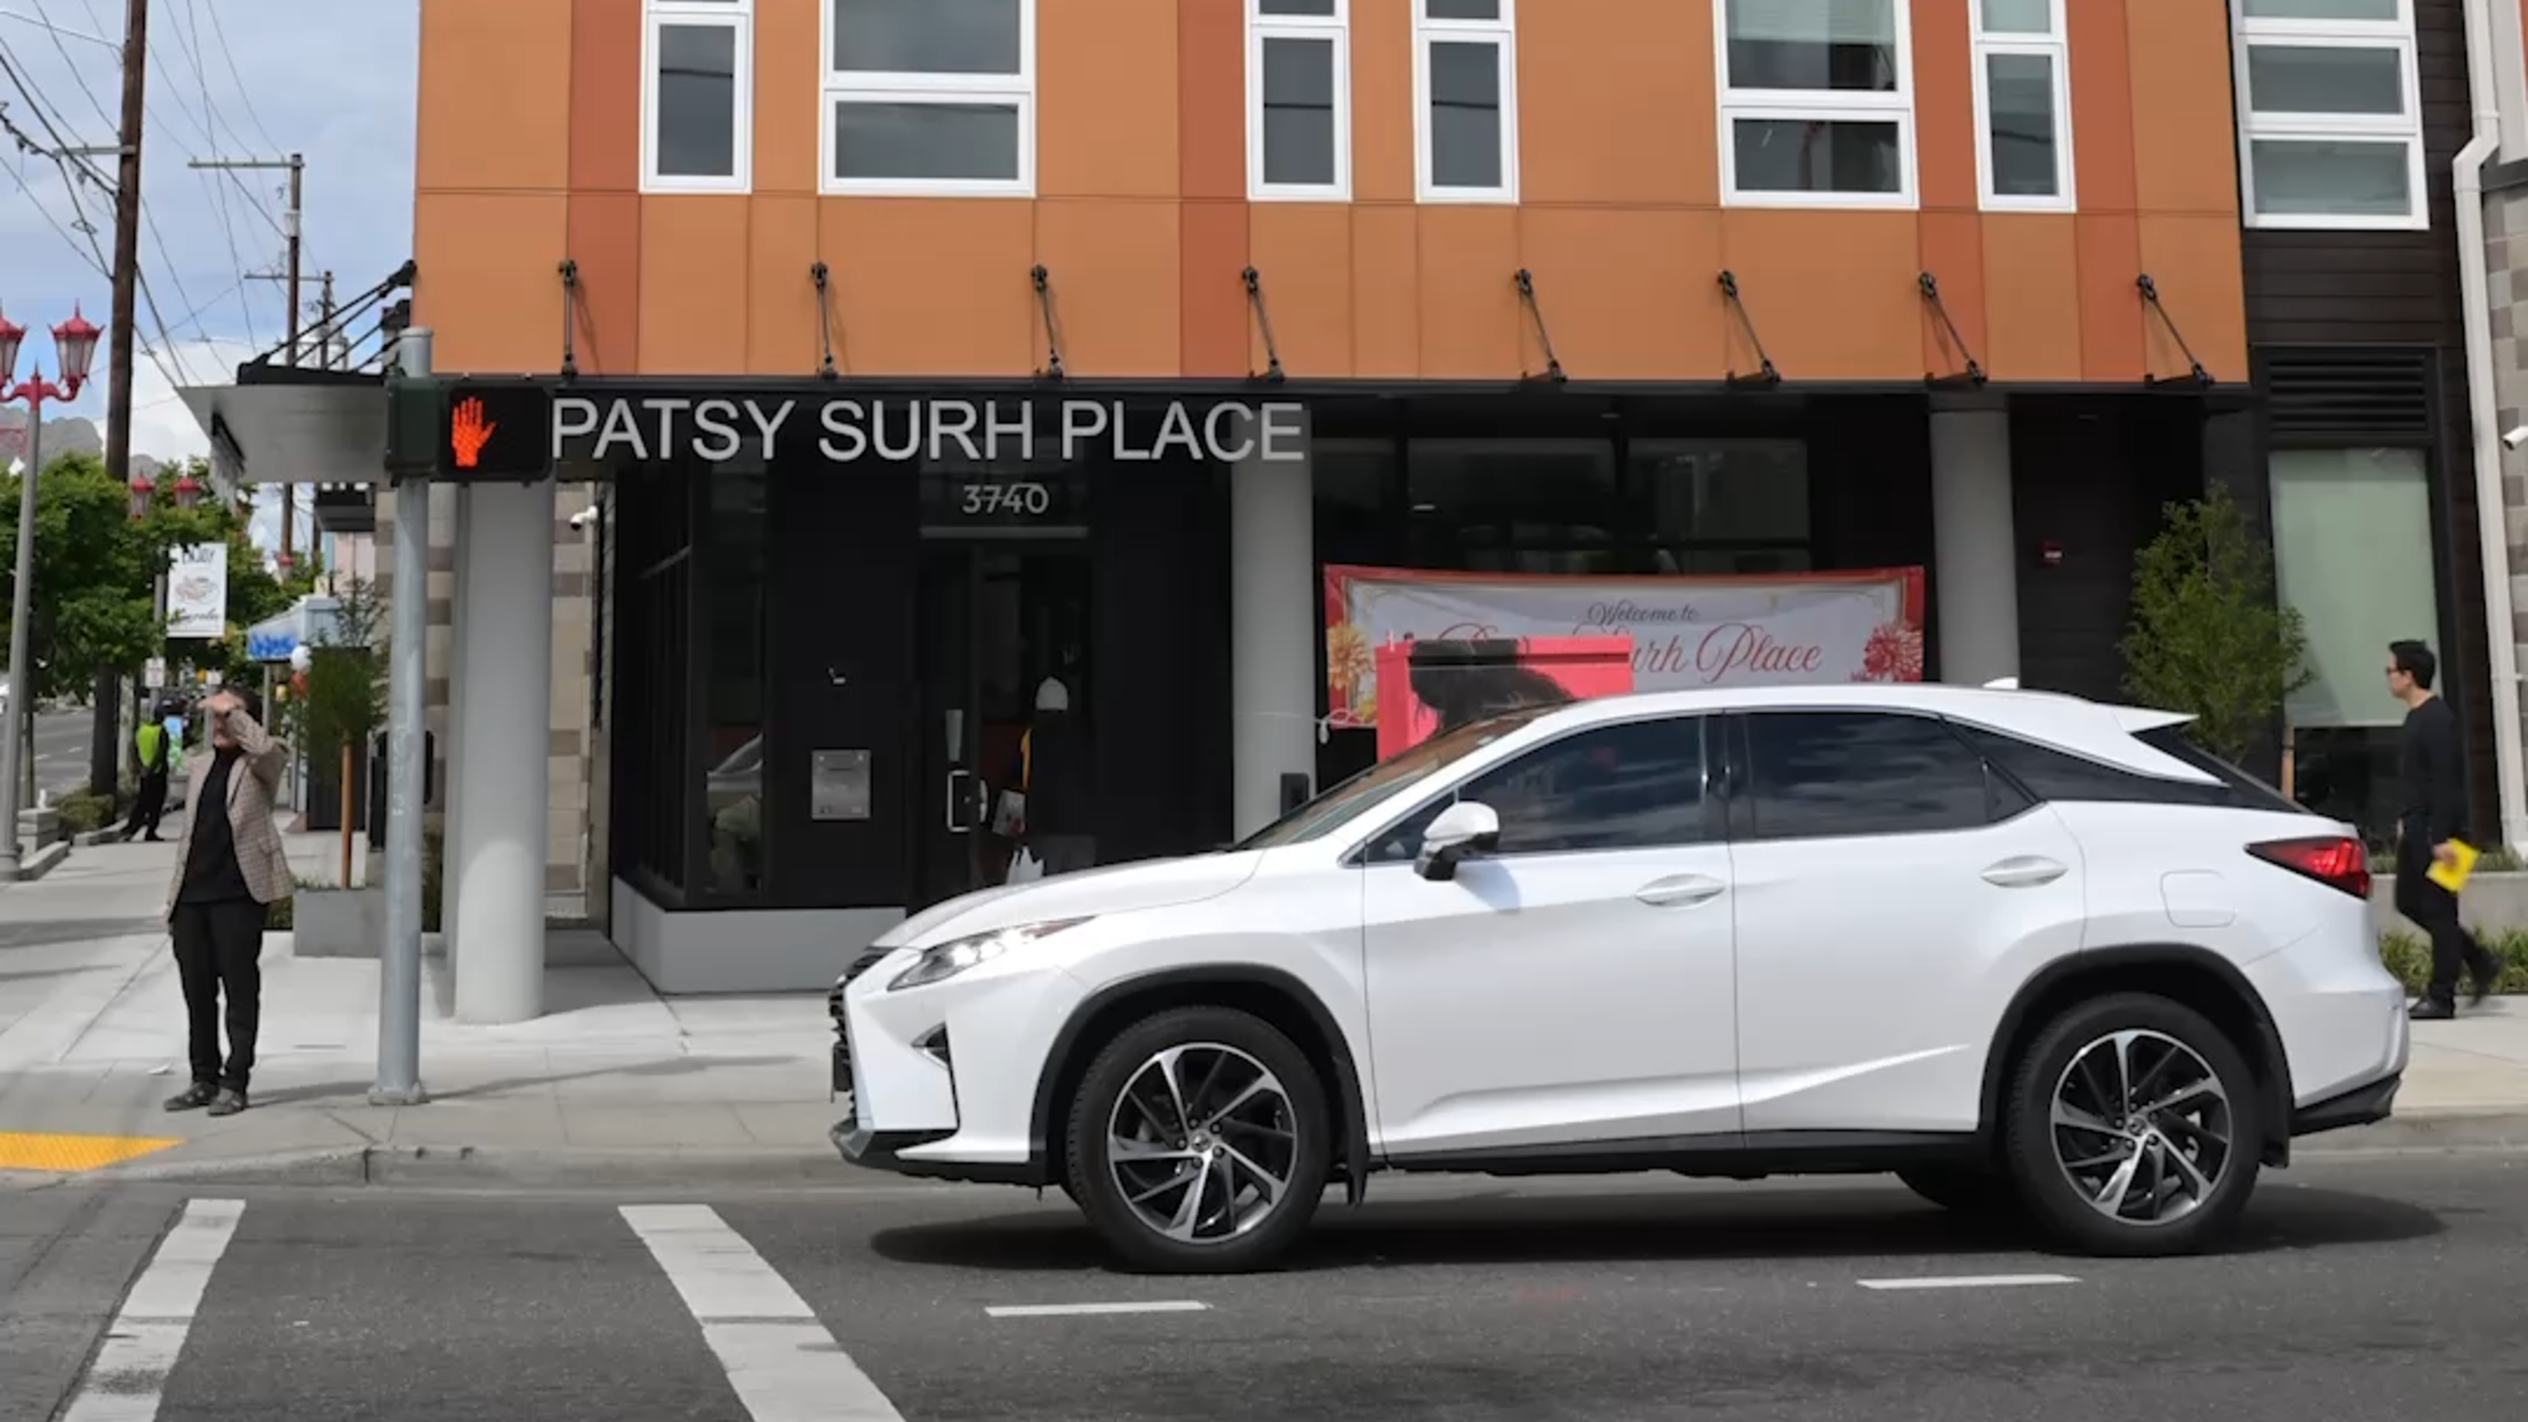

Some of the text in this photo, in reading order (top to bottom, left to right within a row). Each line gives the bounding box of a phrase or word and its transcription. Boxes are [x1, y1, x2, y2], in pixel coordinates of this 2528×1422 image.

[552, 398, 1305, 462] PATSY SURH PLACE
[961, 483, 1050, 514] 3740
[1587, 599, 1697, 626] Welcome to
[1696, 622, 1823, 684] Place
